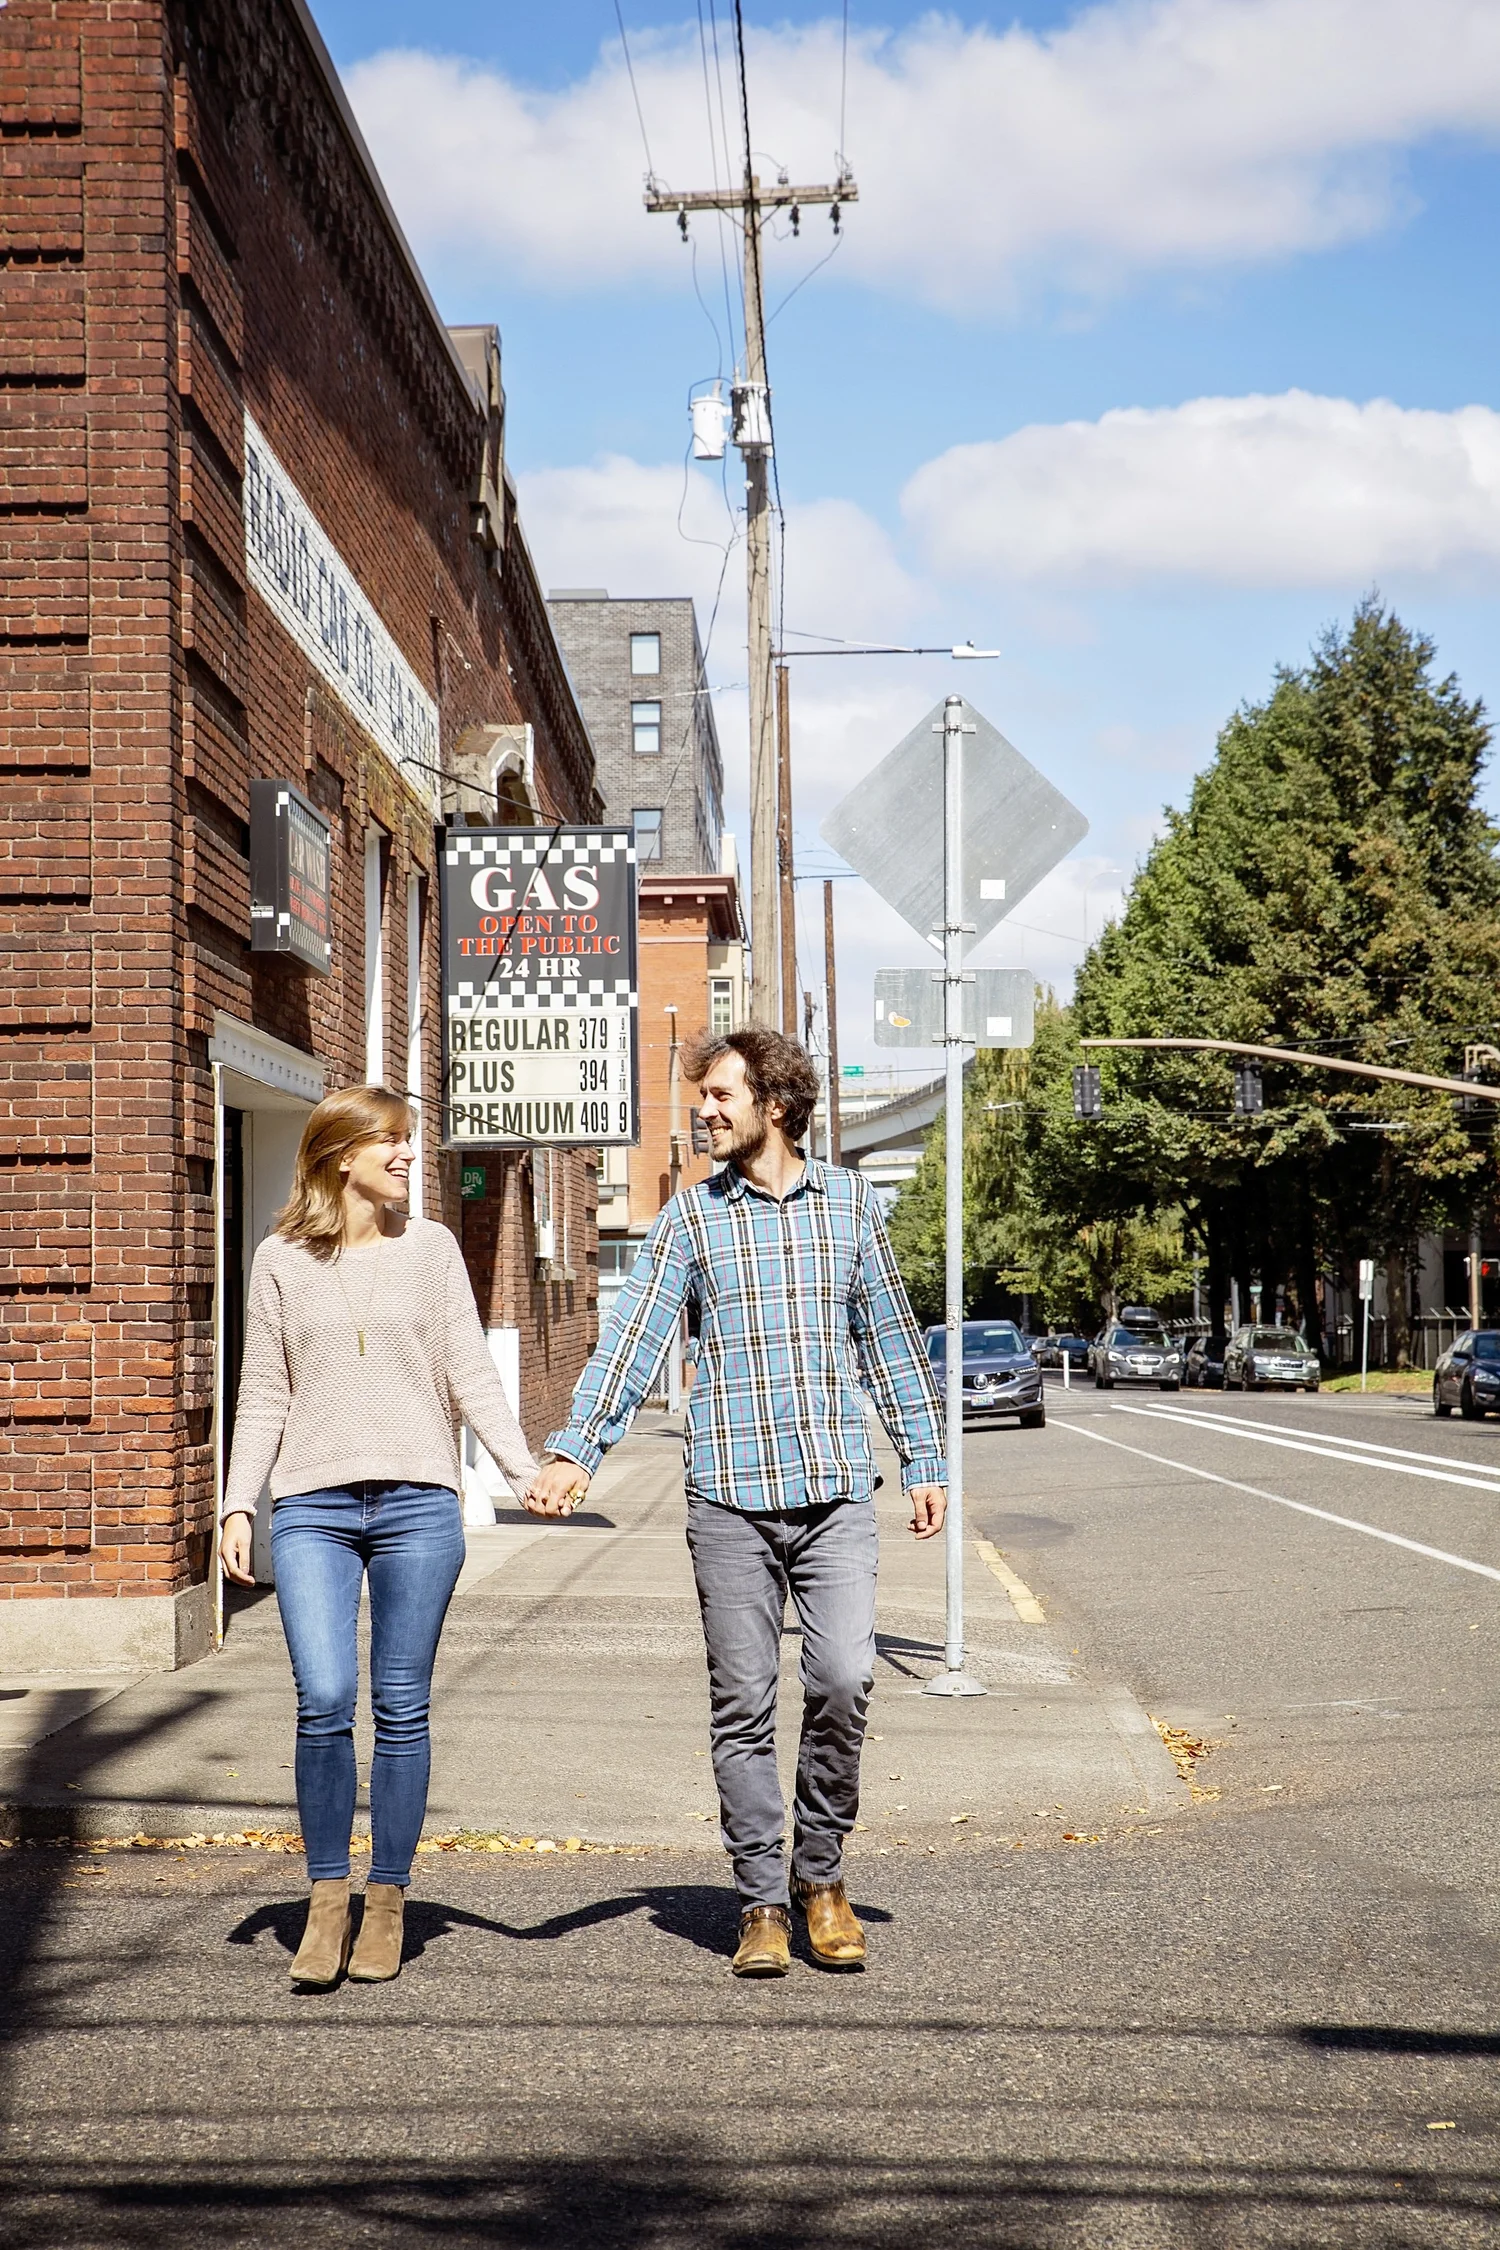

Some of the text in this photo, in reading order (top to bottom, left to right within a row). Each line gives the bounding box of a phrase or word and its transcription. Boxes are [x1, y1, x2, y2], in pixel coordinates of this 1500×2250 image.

[248, 443, 310, 621] RADIO
[319, 557, 348, 676] CAB
[289, 826, 305, 875] CAR
[305, 840, 326, 893] WASH
[470, 864, 600, 912] GAS
[478, 914, 599, 935] OPEN TO
[457, 935, 621, 957] THE PUBLIC
[499, 957, 583, 978] 24 HR
[452, 1017, 608, 1052] REGULAR 379
[452, 1059, 608, 1093] PLUS 394
[452, 1101, 627, 1135] PREMIUM 409 9
